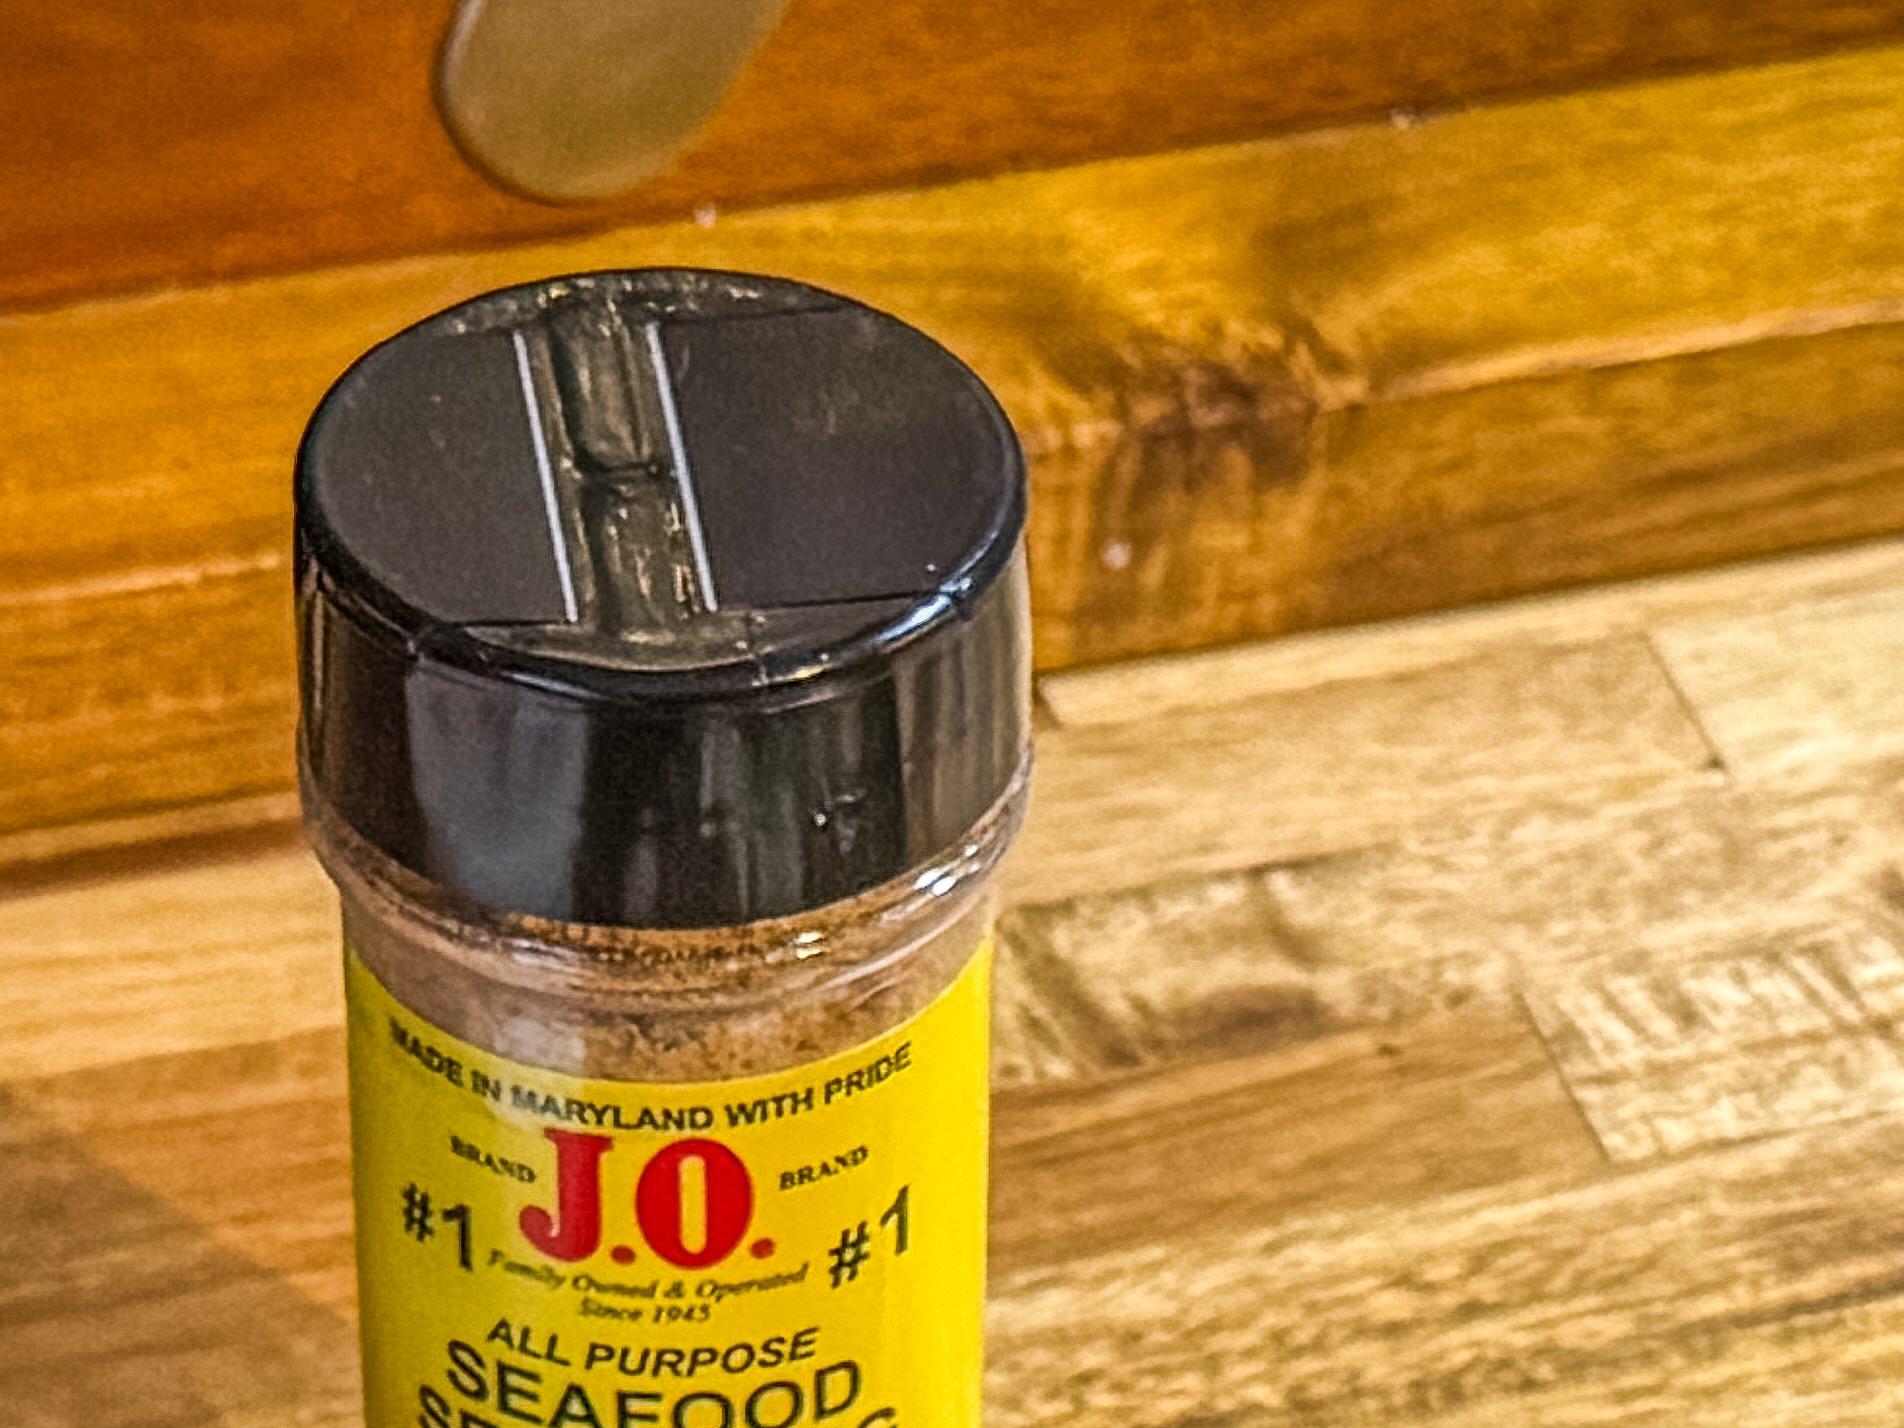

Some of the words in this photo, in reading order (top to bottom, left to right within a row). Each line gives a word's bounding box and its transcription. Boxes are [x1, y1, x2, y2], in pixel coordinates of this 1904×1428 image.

[389, 1016, 465, 1088] MADE
[471, 1069, 502, 1101] IN
[510, 1085, 713, 1130] MARYLAND
[724, 1087, 814, 1127] WITH
[824, 1040, 912, 1105] PRIDE
[450, 1135, 536, 1183] BRAND
[519, 1126, 776, 1271] J.O.
[779, 1145, 869, 1190] BRAND
[402, 1183, 473, 1272] #1
[828, 1184, 910, 1289] #1
[487, 1317, 571, 1367] ALL
[586, 1327, 819, 1379] PURPOSE
